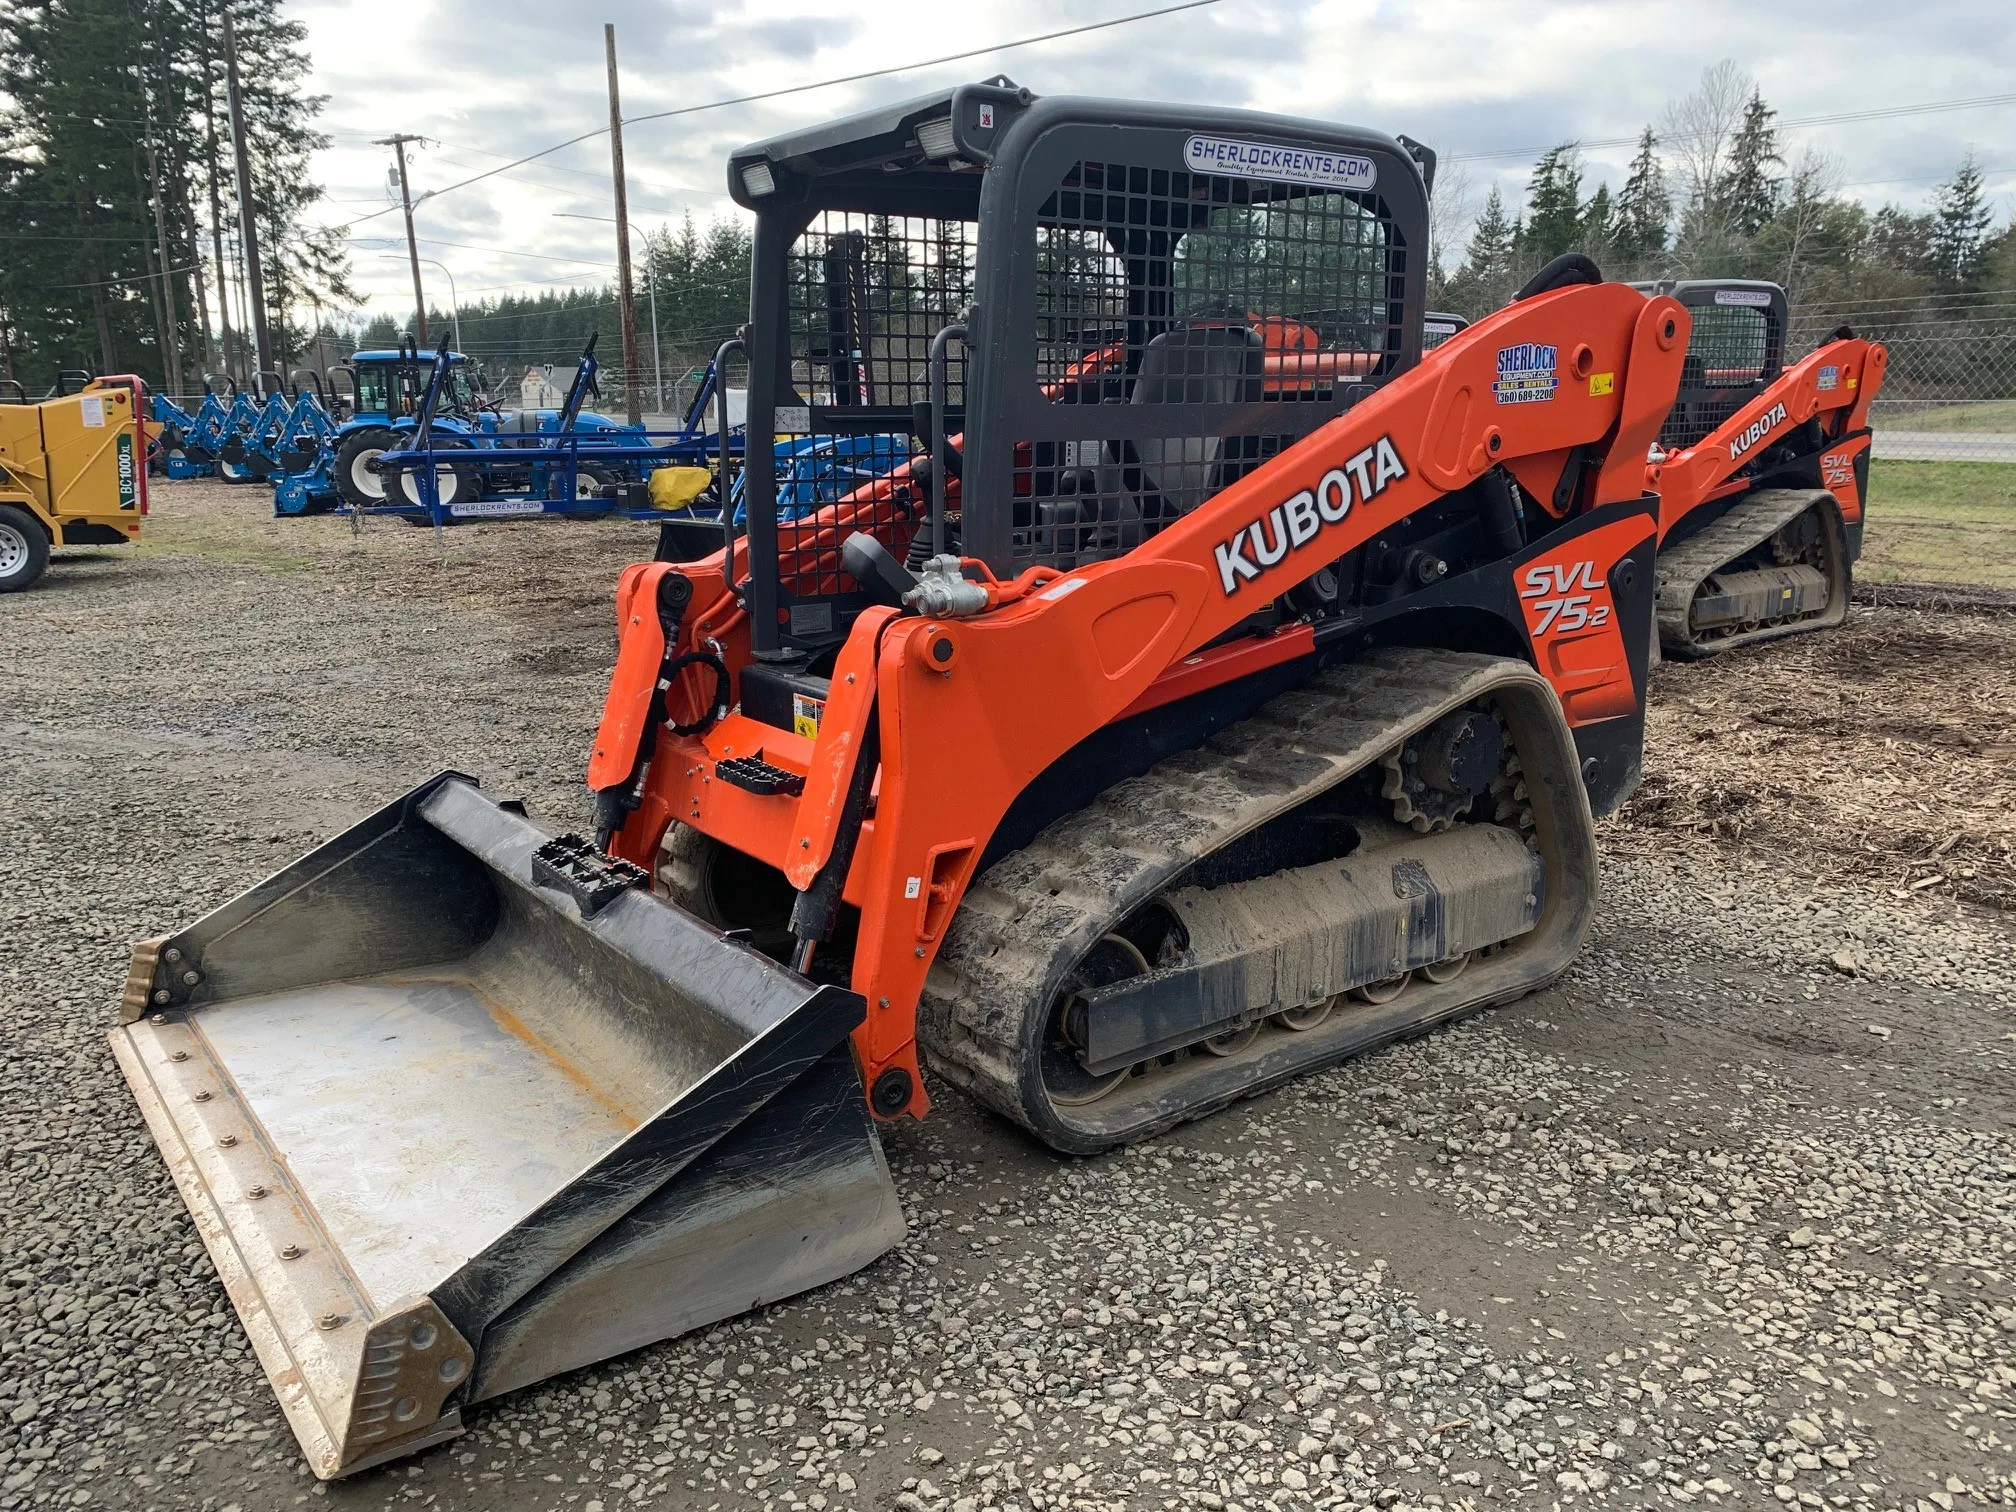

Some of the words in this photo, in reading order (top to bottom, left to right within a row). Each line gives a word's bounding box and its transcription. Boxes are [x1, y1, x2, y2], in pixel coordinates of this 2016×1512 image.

[1192, 141, 1370, 177] SHERLOCKRENTS.COM
[1217, 161, 1243, 172] Quality
[1246, 165, 1283, 175] Equipment
[1285, 169, 1309, 179] Rentals
[1497, 345, 1557, 372] SHERLOCK
[1497, 382, 1519, 390] SALES
[1524, 379, 1553, 388] RENTALS
[1502, 371, 1551, 380] EQUIPMENT.COM
[1496, 390, 1517, 404] (360)
[1518, 388, 1554, 401] 689-2208
[1729, 402, 1787, 460] KUBOTA
[1823, 455, 1851, 468] SVL
[454, 503, 540, 512] SHERLOCKRENTS.COM
[1214, 436, 1405, 595] KUBOTA
[1521, 560, 1606, 598] SVL
[1532, 594, 1610, 637] 75-2
